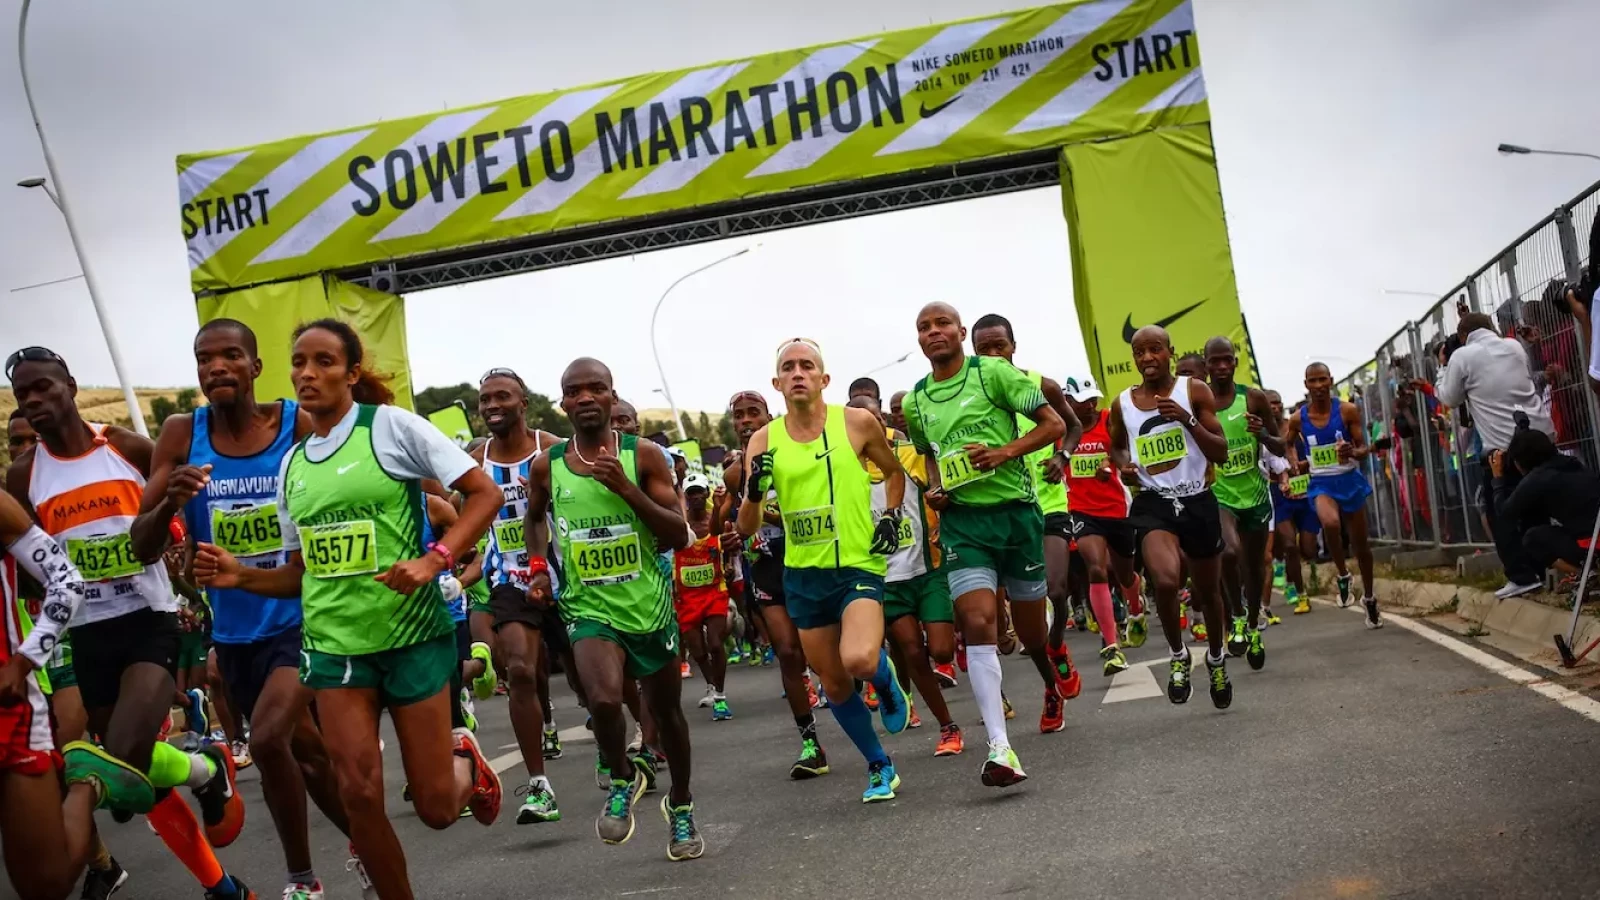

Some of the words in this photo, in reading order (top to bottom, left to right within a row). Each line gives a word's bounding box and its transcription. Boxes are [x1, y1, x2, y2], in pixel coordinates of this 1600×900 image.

[911, 56, 941, 73] NIKE
[945, 47, 994, 68] SOWETO
[1000, 36, 1064, 60] MARATHON
[1091, 29, 1193, 82] START
[915, 78, 942, 93] 2014
[347, 119, 576, 217] SOWETO
[594, 63, 905, 174] MARATHON
[181, 188, 271, 240] START
[1106, 361, 1133, 376] NIKE
[1074, 442, 1105, 451] YOTA
[1141, 434, 1185, 459] 41088
[946, 456, 969, 480] 411
[1074, 459, 1102, 472] 4048
[206, 476, 279, 497] INGWAVUMA
[53, 495, 121, 520] MAKANA
[217, 514, 282, 545] 42465
[569, 511, 636, 531] NEDBAN
[791, 514, 835, 538] 40374
[75, 541, 137, 571] 45218
[308, 533, 370, 565] 45577
[578, 543, 638, 571] 43600
[684, 568, 714, 583] 40293
